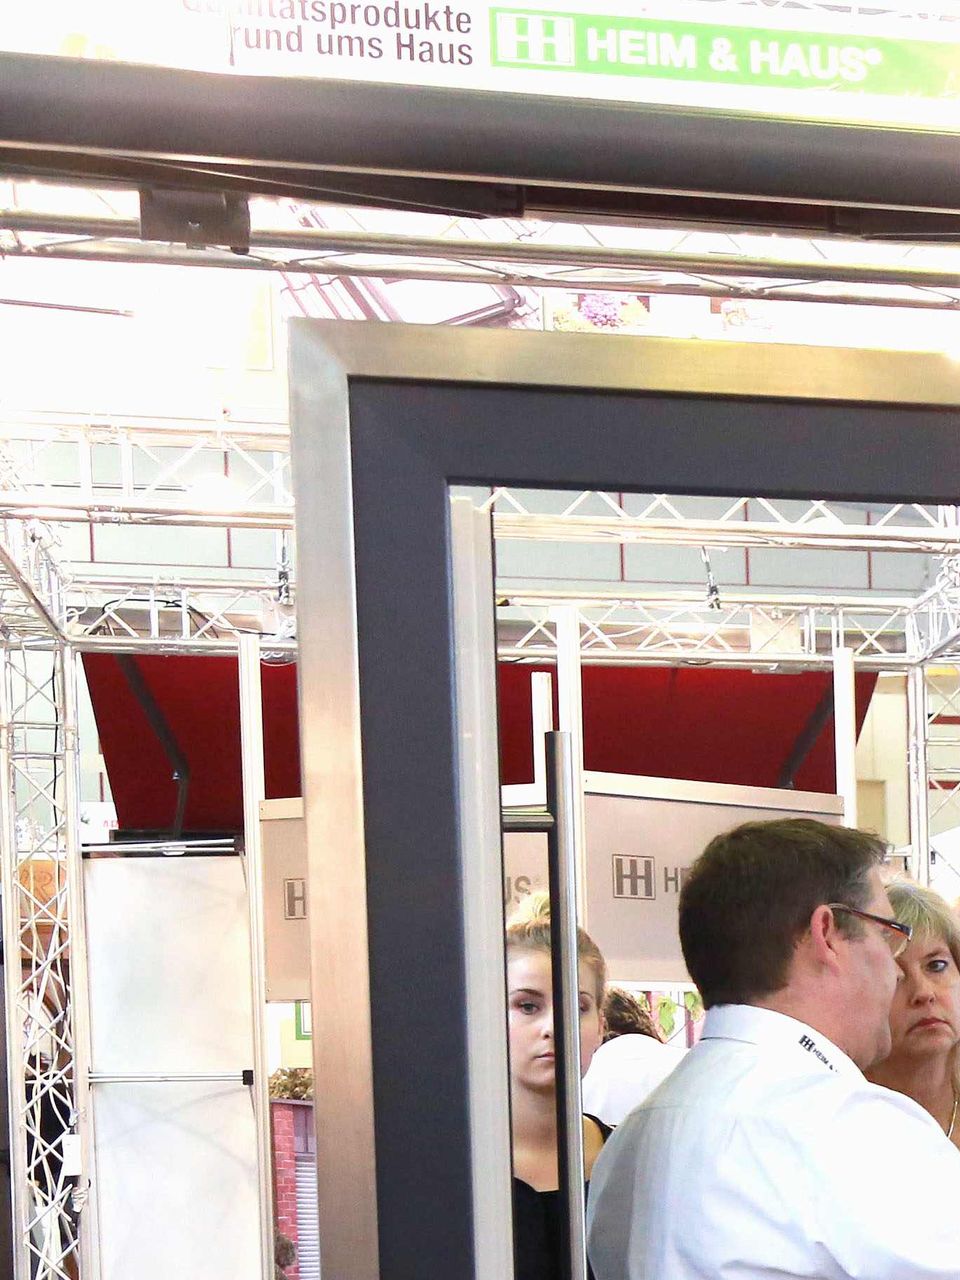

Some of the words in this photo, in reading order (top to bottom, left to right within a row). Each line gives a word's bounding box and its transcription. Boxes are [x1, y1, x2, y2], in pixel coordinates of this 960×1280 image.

[316, 33, 384, 59] ums
[396, 32, 473, 65] Haus
[586, 27, 697, 69] HEIM
[708, 37, 738, 72] &
